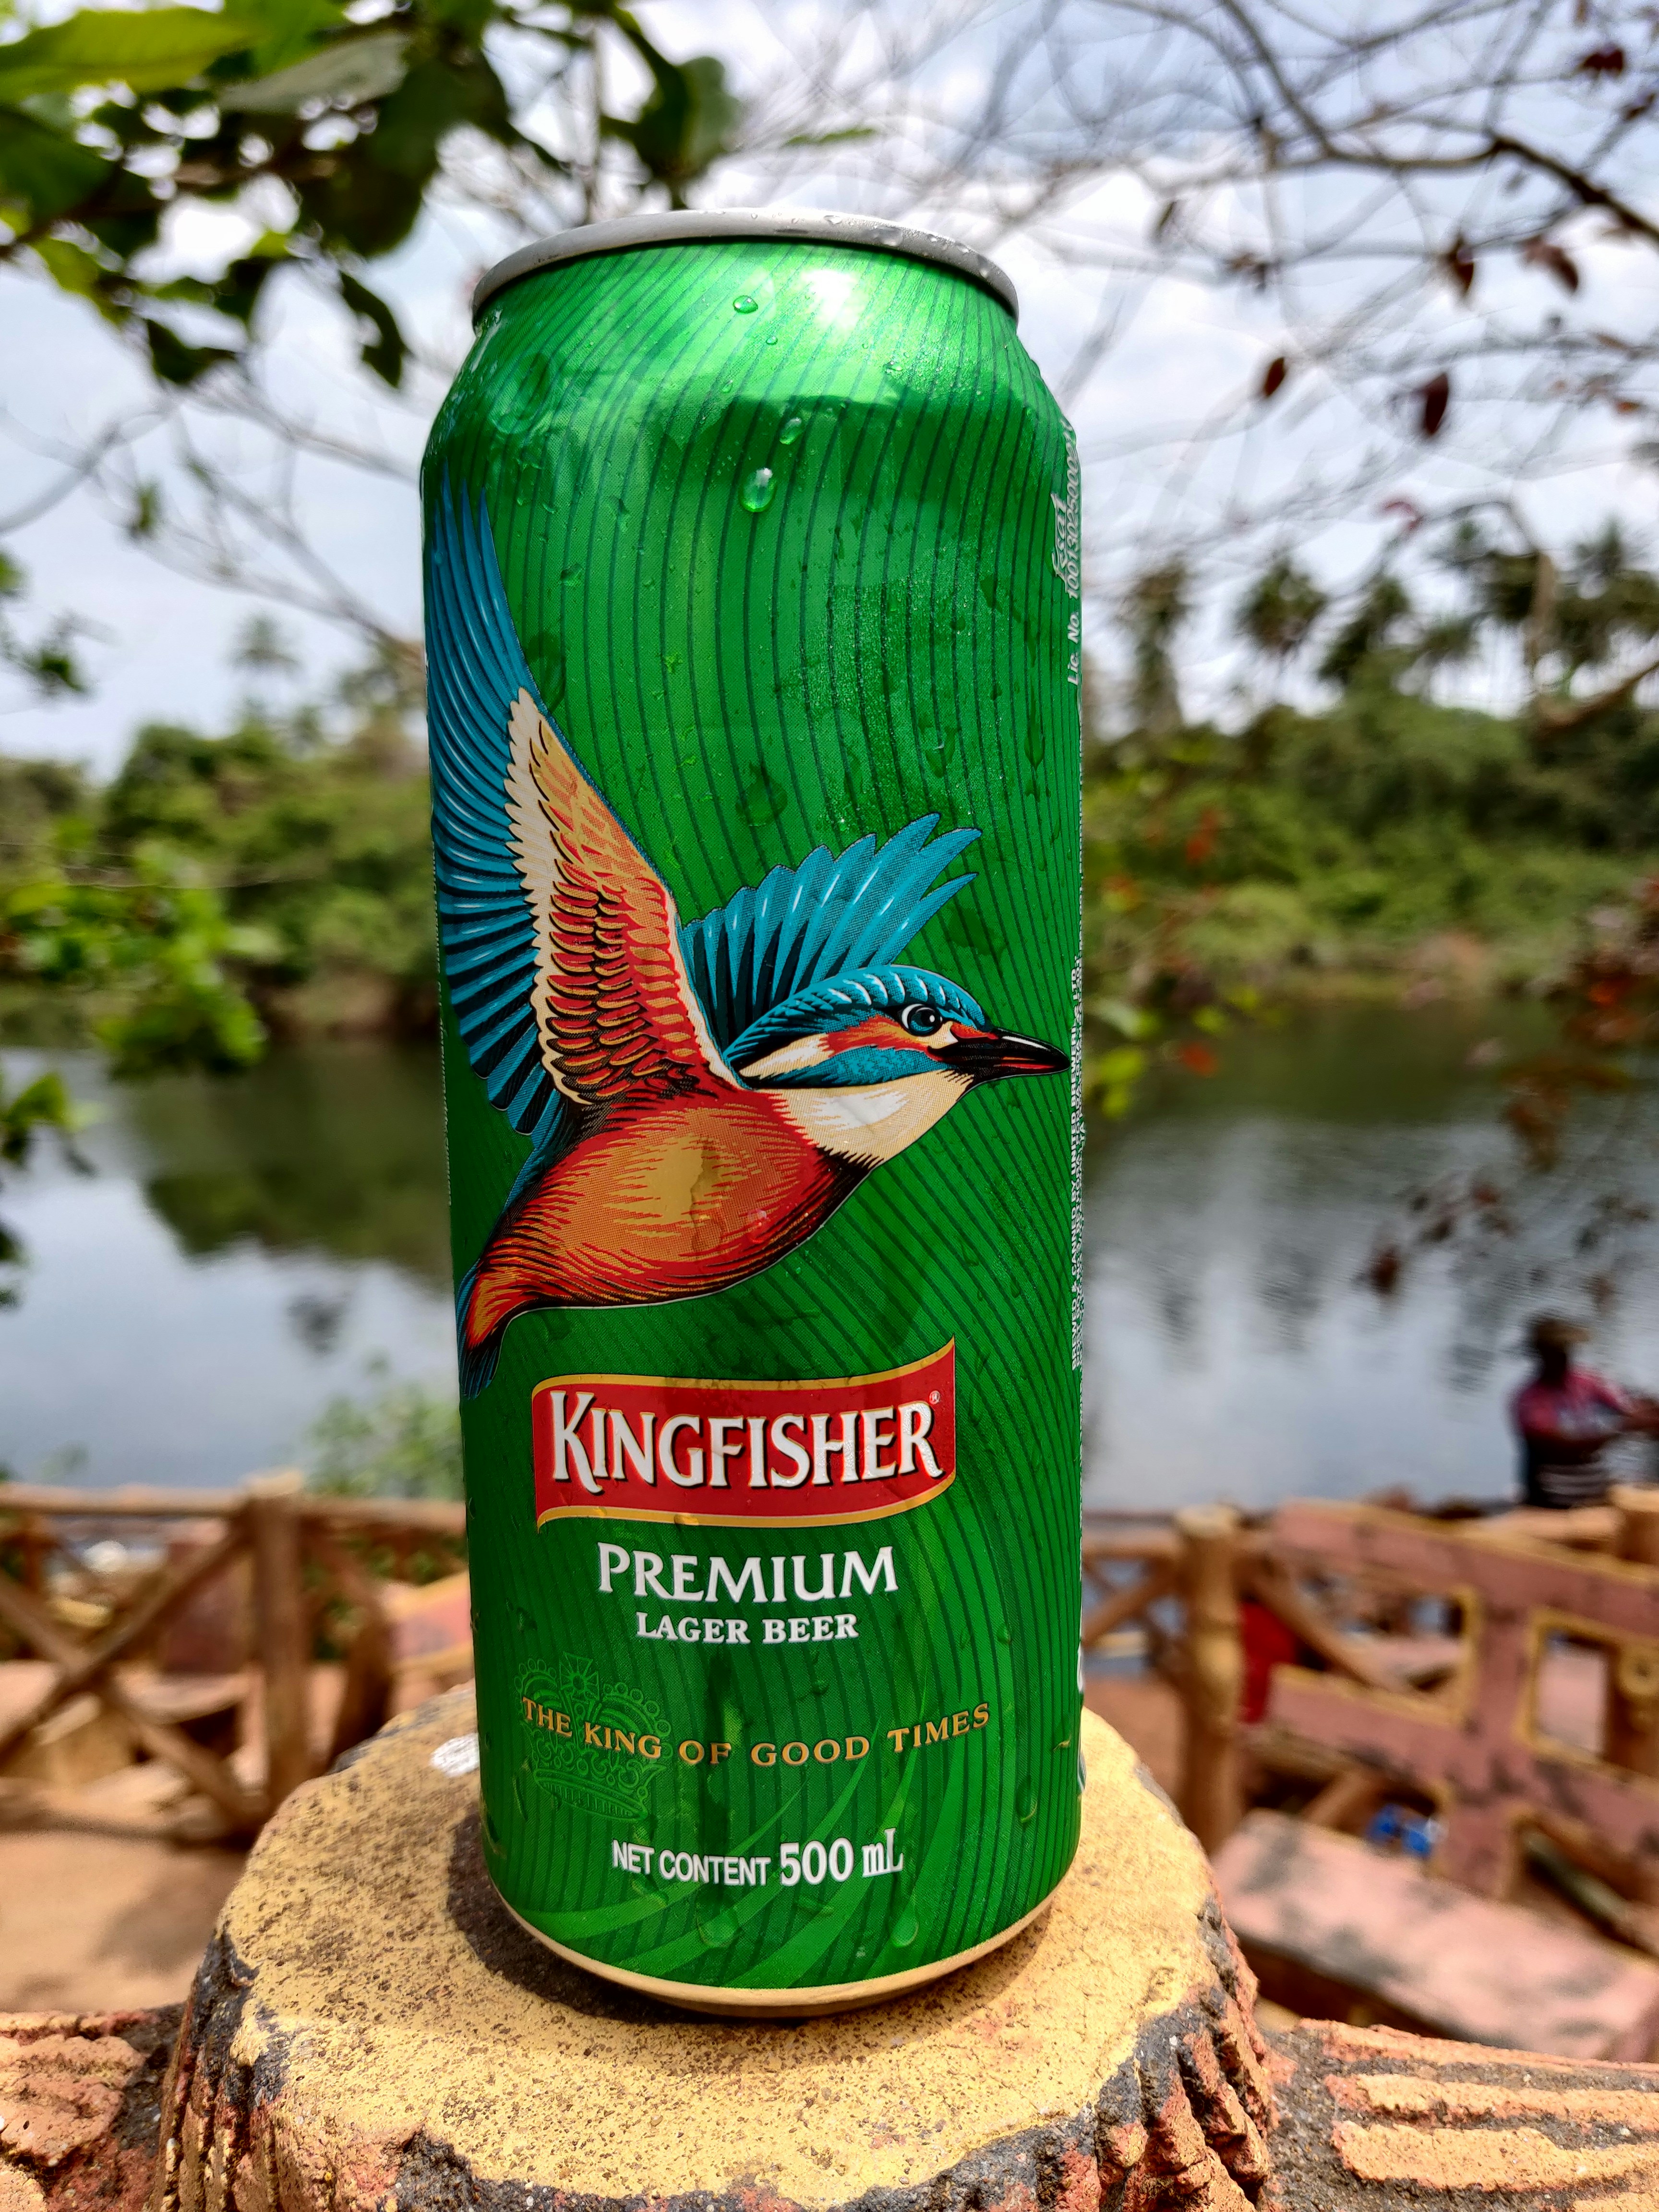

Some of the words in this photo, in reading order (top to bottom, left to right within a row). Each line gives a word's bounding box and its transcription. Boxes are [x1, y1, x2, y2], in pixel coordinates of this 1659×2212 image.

[1068, 610, 1079, 644] No.
[1071, 1179, 1076, 1202] BY
[1071, 1280, 1077, 1292] &
[550, 1390, 942, 1494] KINGFISHER
[598, 1542, 898, 1603] PREMIUM
[636, 1612, 750, 1644] LAGER
[762, 1613, 859, 1644] BEER
[522, 1696, 573, 1737] THE
[584, 1721, 661, 1759] KING
[679, 1740, 732, 1765] OF
[750, 1736, 869, 1766] GOOD
[888, 1702, 989, 1753] TIMES
[612, 1839, 654, 1874] NET
[659, 1850, 770, 1886] CONTENT
[780, 1837, 854, 1886] 500
[862, 1827, 903, 1877] mL
